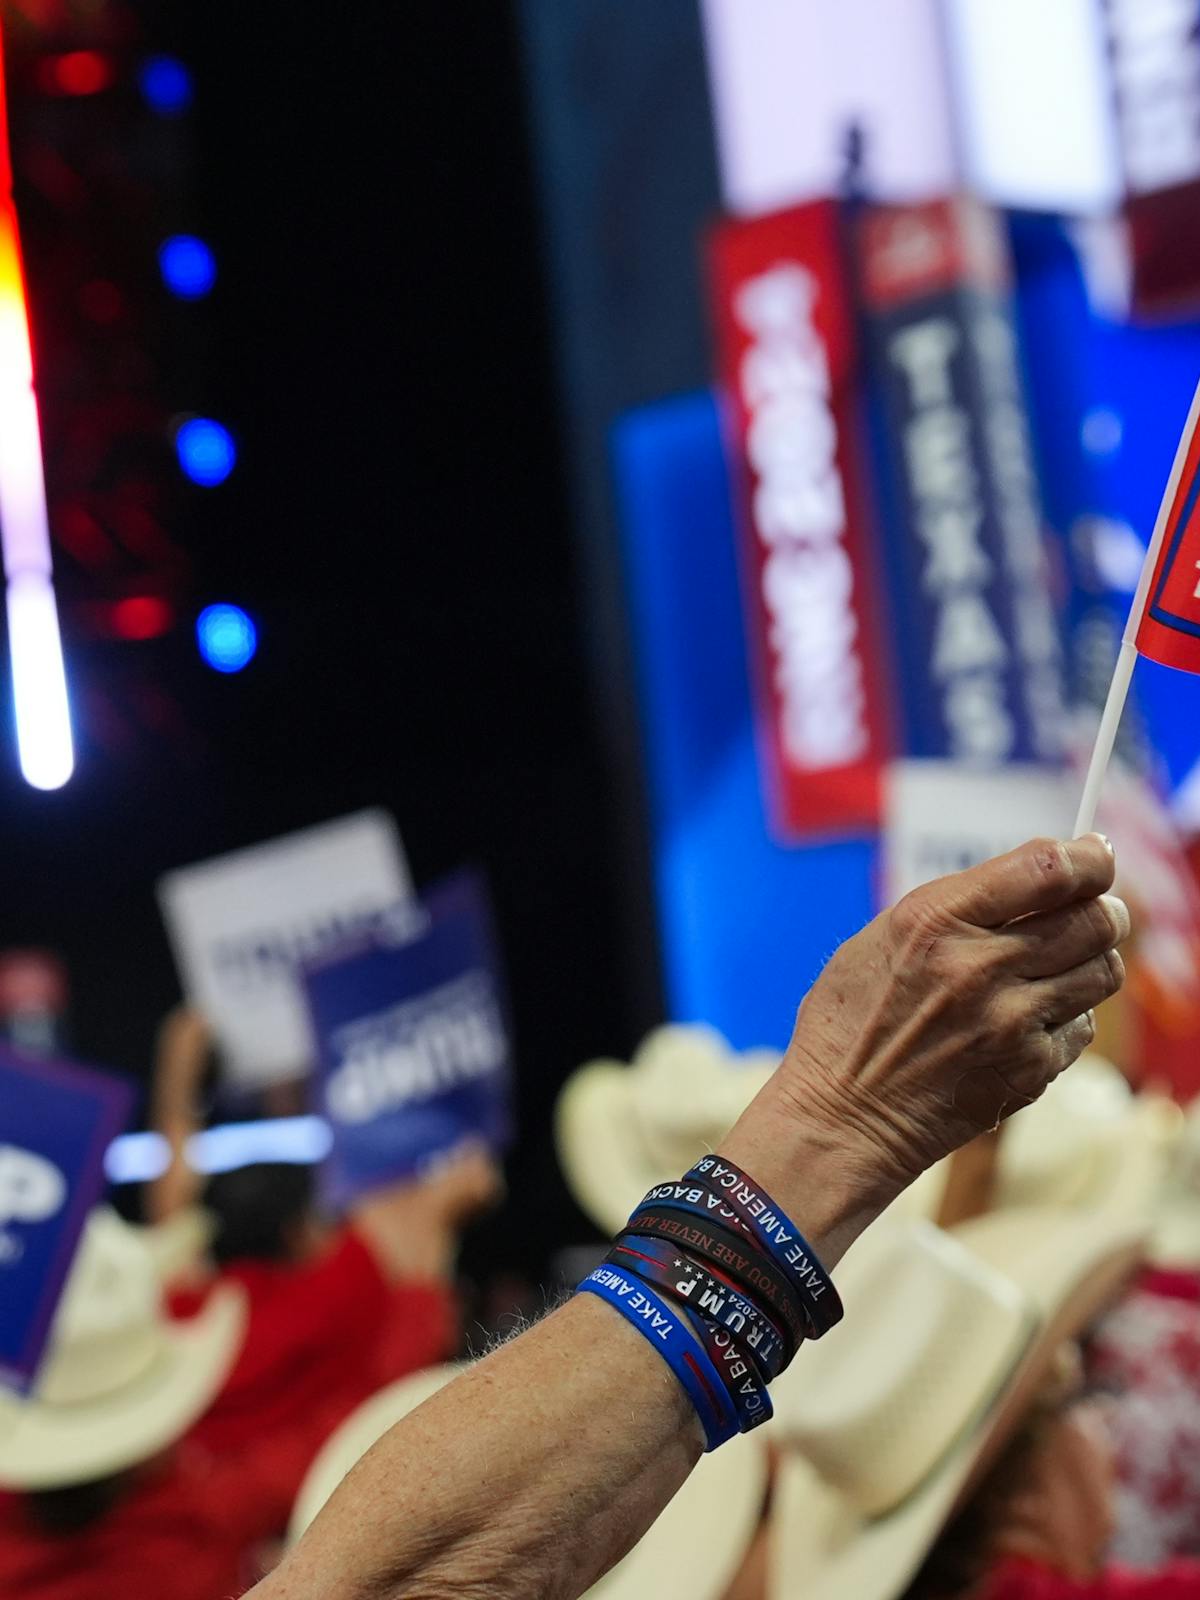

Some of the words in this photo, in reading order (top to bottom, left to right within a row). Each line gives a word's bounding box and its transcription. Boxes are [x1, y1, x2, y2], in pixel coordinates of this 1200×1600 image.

[890, 318, 1012, 758] TEXAS
[705, 1164, 793, 1244] AMERICA
[655, 1217, 714, 1250] NEVER
[712, 1246, 750, 1272] ARE
[784, 1244, 827, 1302] TAKE
[627, 1294, 677, 1341] TAKE
[675, 1279, 770, 1362] TRUMP
[728, 1293, 758, 1321] 2024
